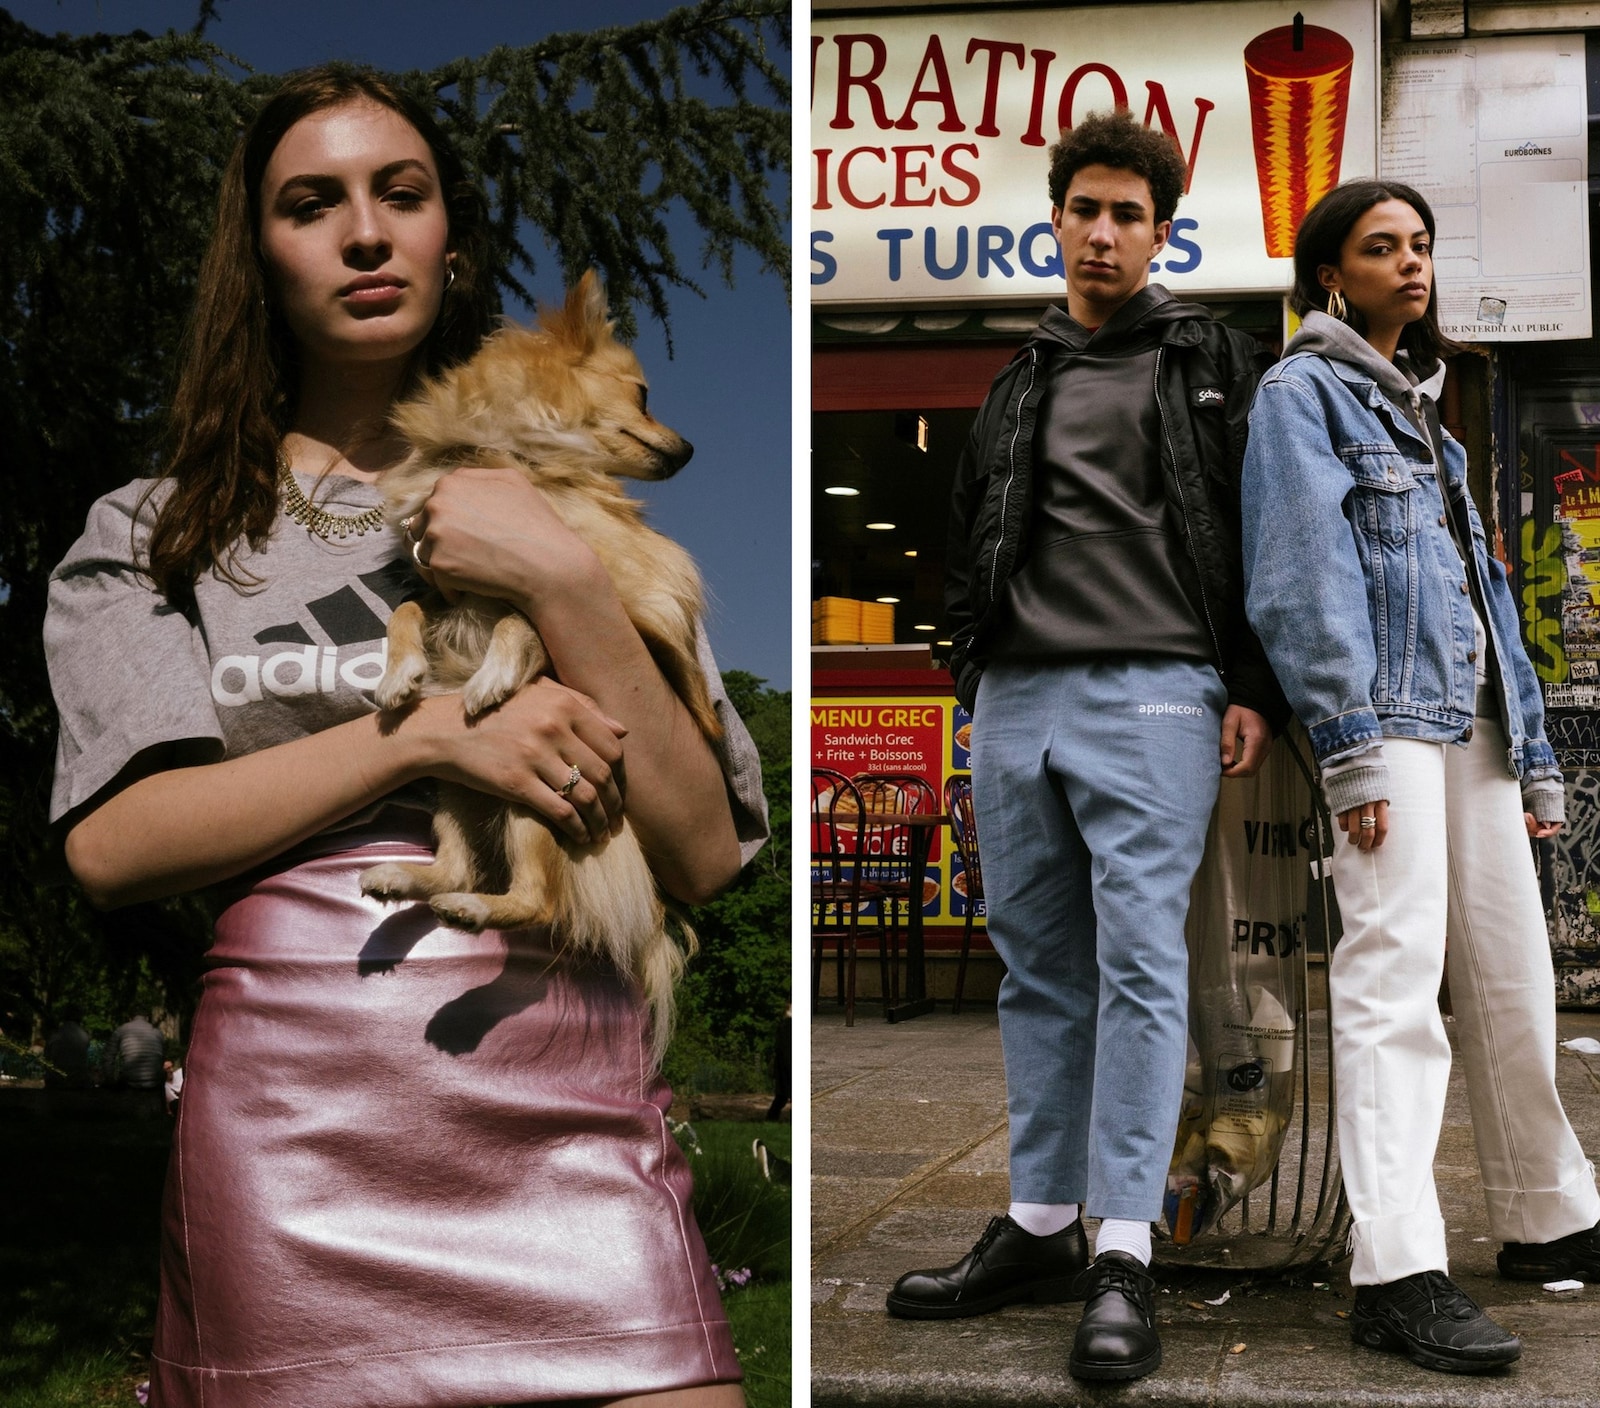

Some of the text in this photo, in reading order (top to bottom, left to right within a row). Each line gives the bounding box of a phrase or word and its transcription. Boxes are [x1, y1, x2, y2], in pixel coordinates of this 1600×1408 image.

[811, 33, 1215, 197] RATION
[1504, 147, 1553, 157] EUROBORNES
[811, 143, 981, 210] ICES
[811, 218, 1203, 285] S TURQS
[1440, 322, 1563, 333] IER INTERDIT AU PUBLIC
[211, 637, 388, 707] adid
[1138, 702, 1203, 717] applecore
[811, 709, 936, 727] MENU GREC
[824, 734, 914, 746] Sandwich Grec
[827, 749, 855, 761] Frite
[870, 749, 923, 761] Boissons
[867, 763, 927, 772] 33cl (sans alcool)
[1232, 1069, 1260, 1086] NF
